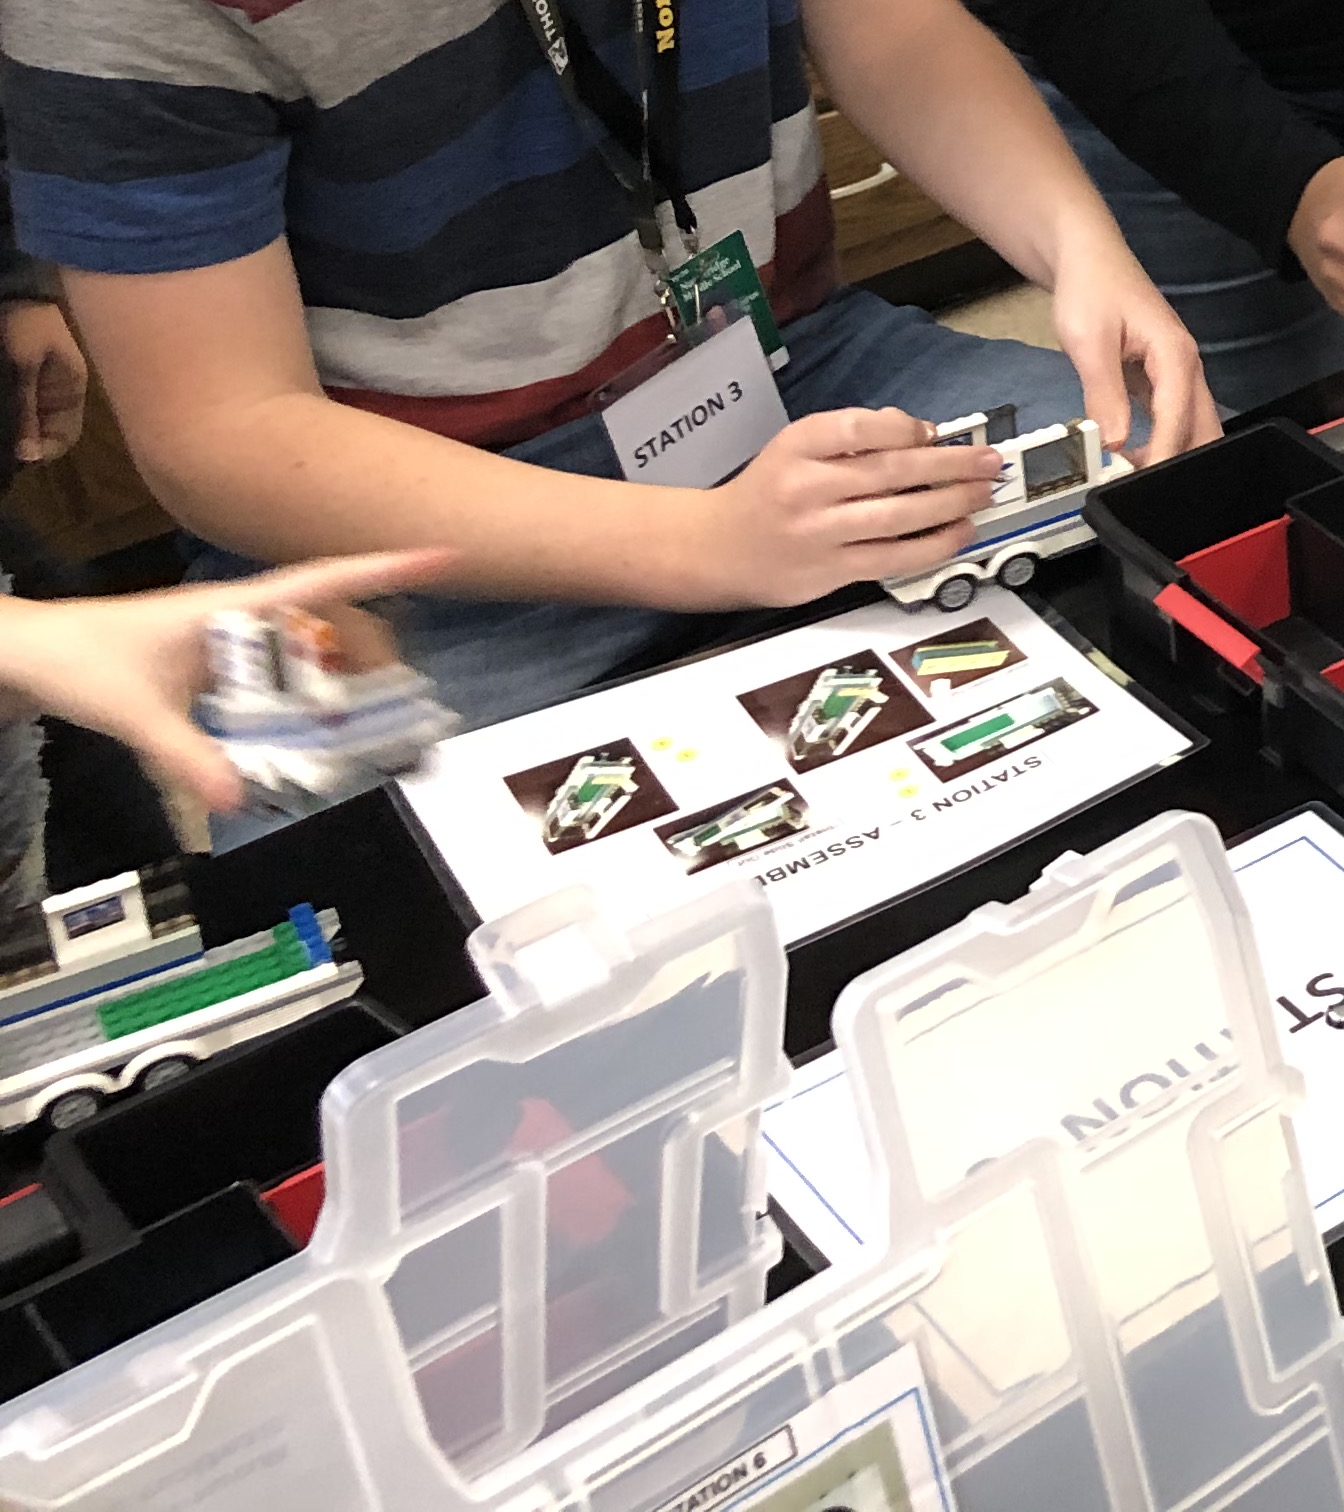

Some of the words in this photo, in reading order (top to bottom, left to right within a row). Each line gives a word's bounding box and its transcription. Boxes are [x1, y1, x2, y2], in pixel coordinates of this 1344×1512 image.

[634, 391, 725, 469] STATION
[727, 380, 744, 403] 3
[929, 754, 1044, 815] STATION
[909, 808, 924, 823] 3
[752, 825, 881, 888] ASSEMBL
[668, 1462, 748, 1512] TATION
[752, 1451, 767, 1469] 6
